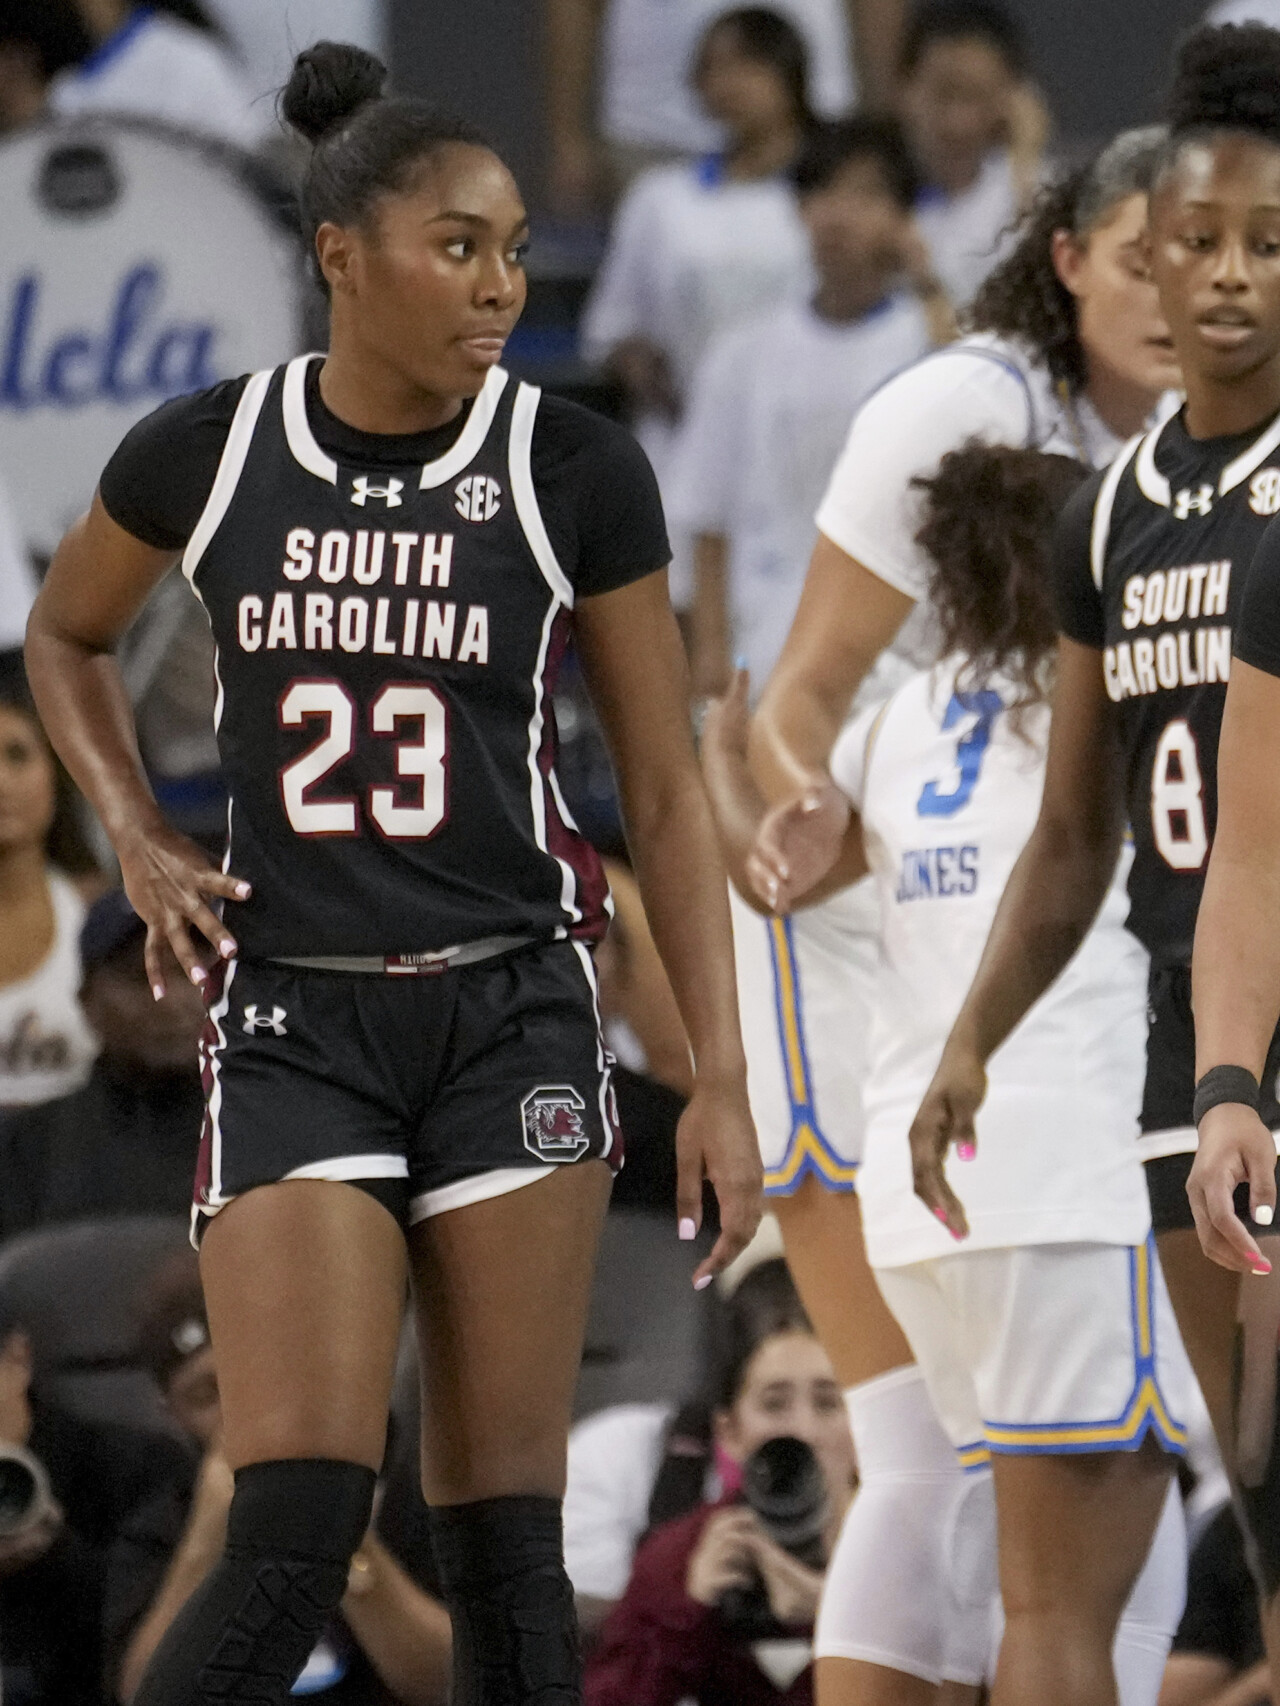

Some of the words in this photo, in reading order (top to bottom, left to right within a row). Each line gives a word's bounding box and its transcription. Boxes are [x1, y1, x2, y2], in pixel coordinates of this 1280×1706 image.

[454, 475, 501, 522] SEC
[282, 527, 455, 588] SOUTH
[1121, 559, 1231, 631] SOUTH
[237, 591, 490, 665] CAROLINA
[1103, 627, 1232, 703] CAROLIN
[279, 676, 450, 840] 23
[916, 690, 1004, 820] 3
[1150, 718, 1210, 874] 8
